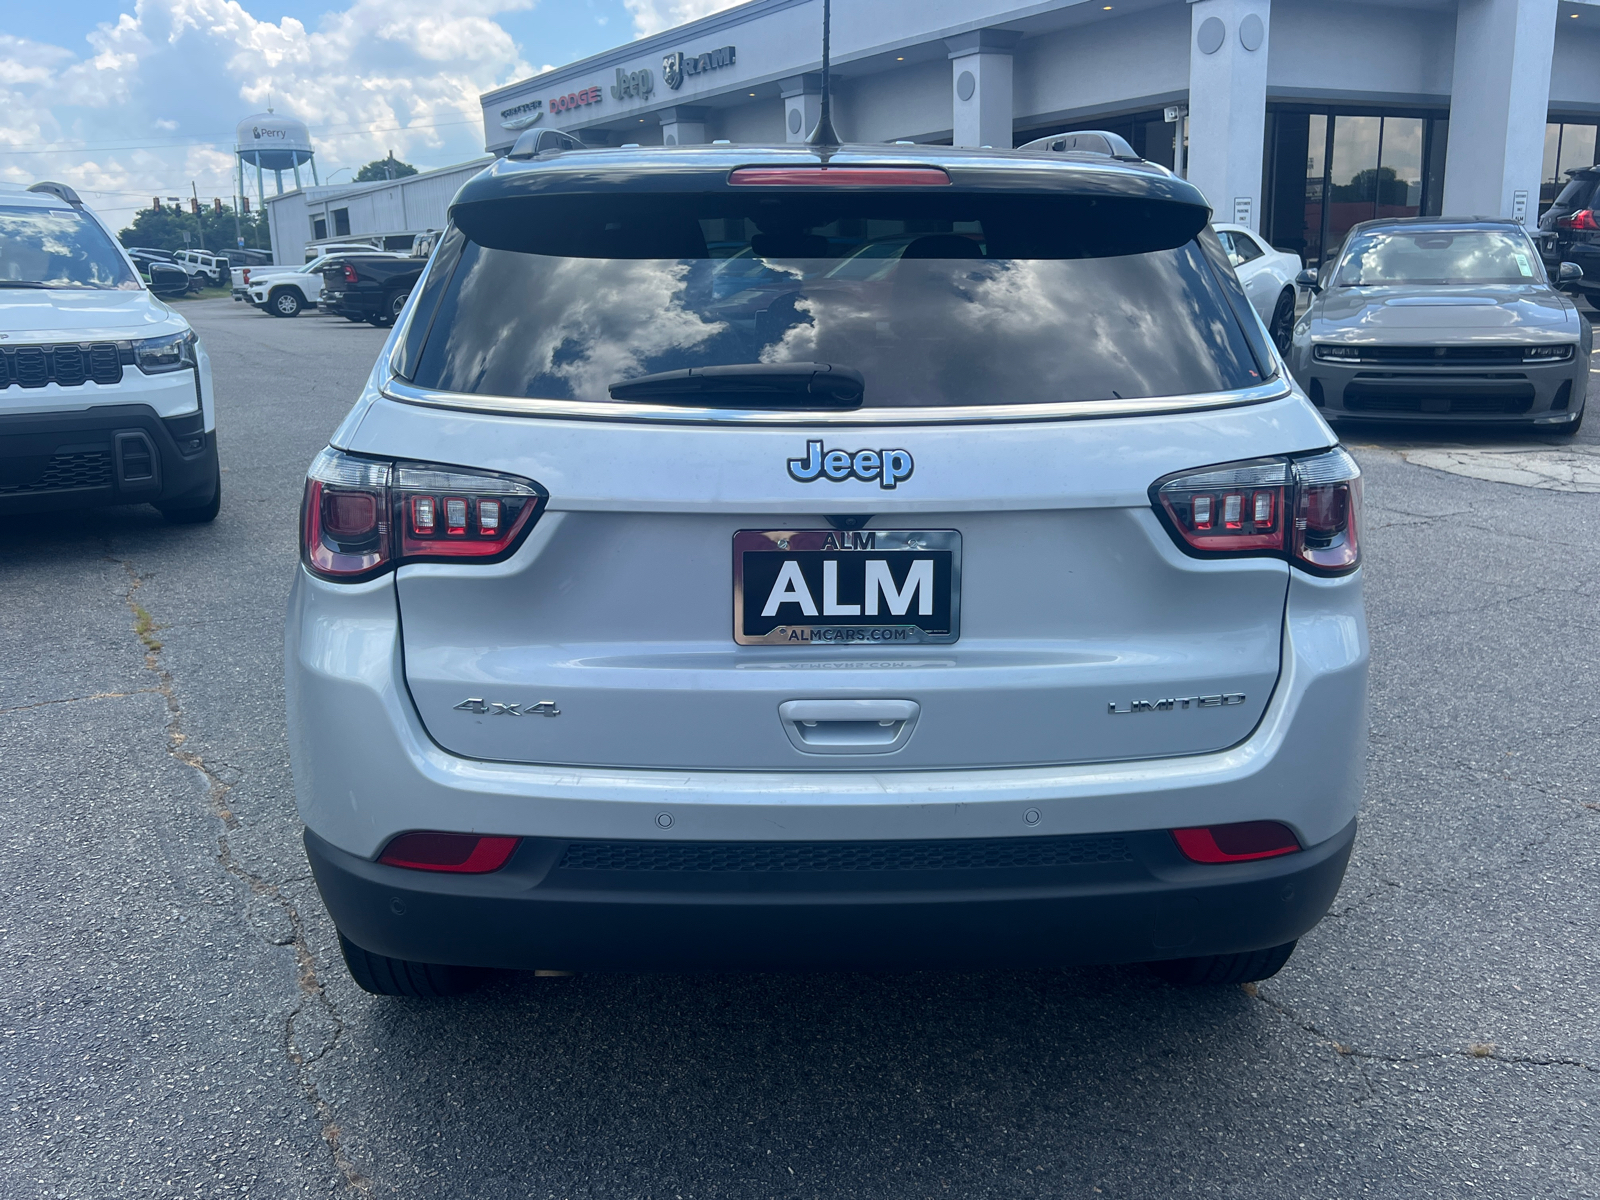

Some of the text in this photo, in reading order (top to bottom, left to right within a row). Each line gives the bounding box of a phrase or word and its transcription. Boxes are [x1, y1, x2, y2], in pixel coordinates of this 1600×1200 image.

[683, 46, 735, 76] RAM
[611, 68, 654, 100] Jeep
[549, 86, 601, 114] DODGE
[261, 128, 286, 139] Perry
[787, 439, 914, 489] Jeep
[822, 531, 876, 550] ALM
[761, 559, 934, 617] ALM
[788, 629, 906, 641] ALMCARS.COM
[453, 697, 561, 717] 4x4
[1108, 692, 1246, 714] LIMITED
